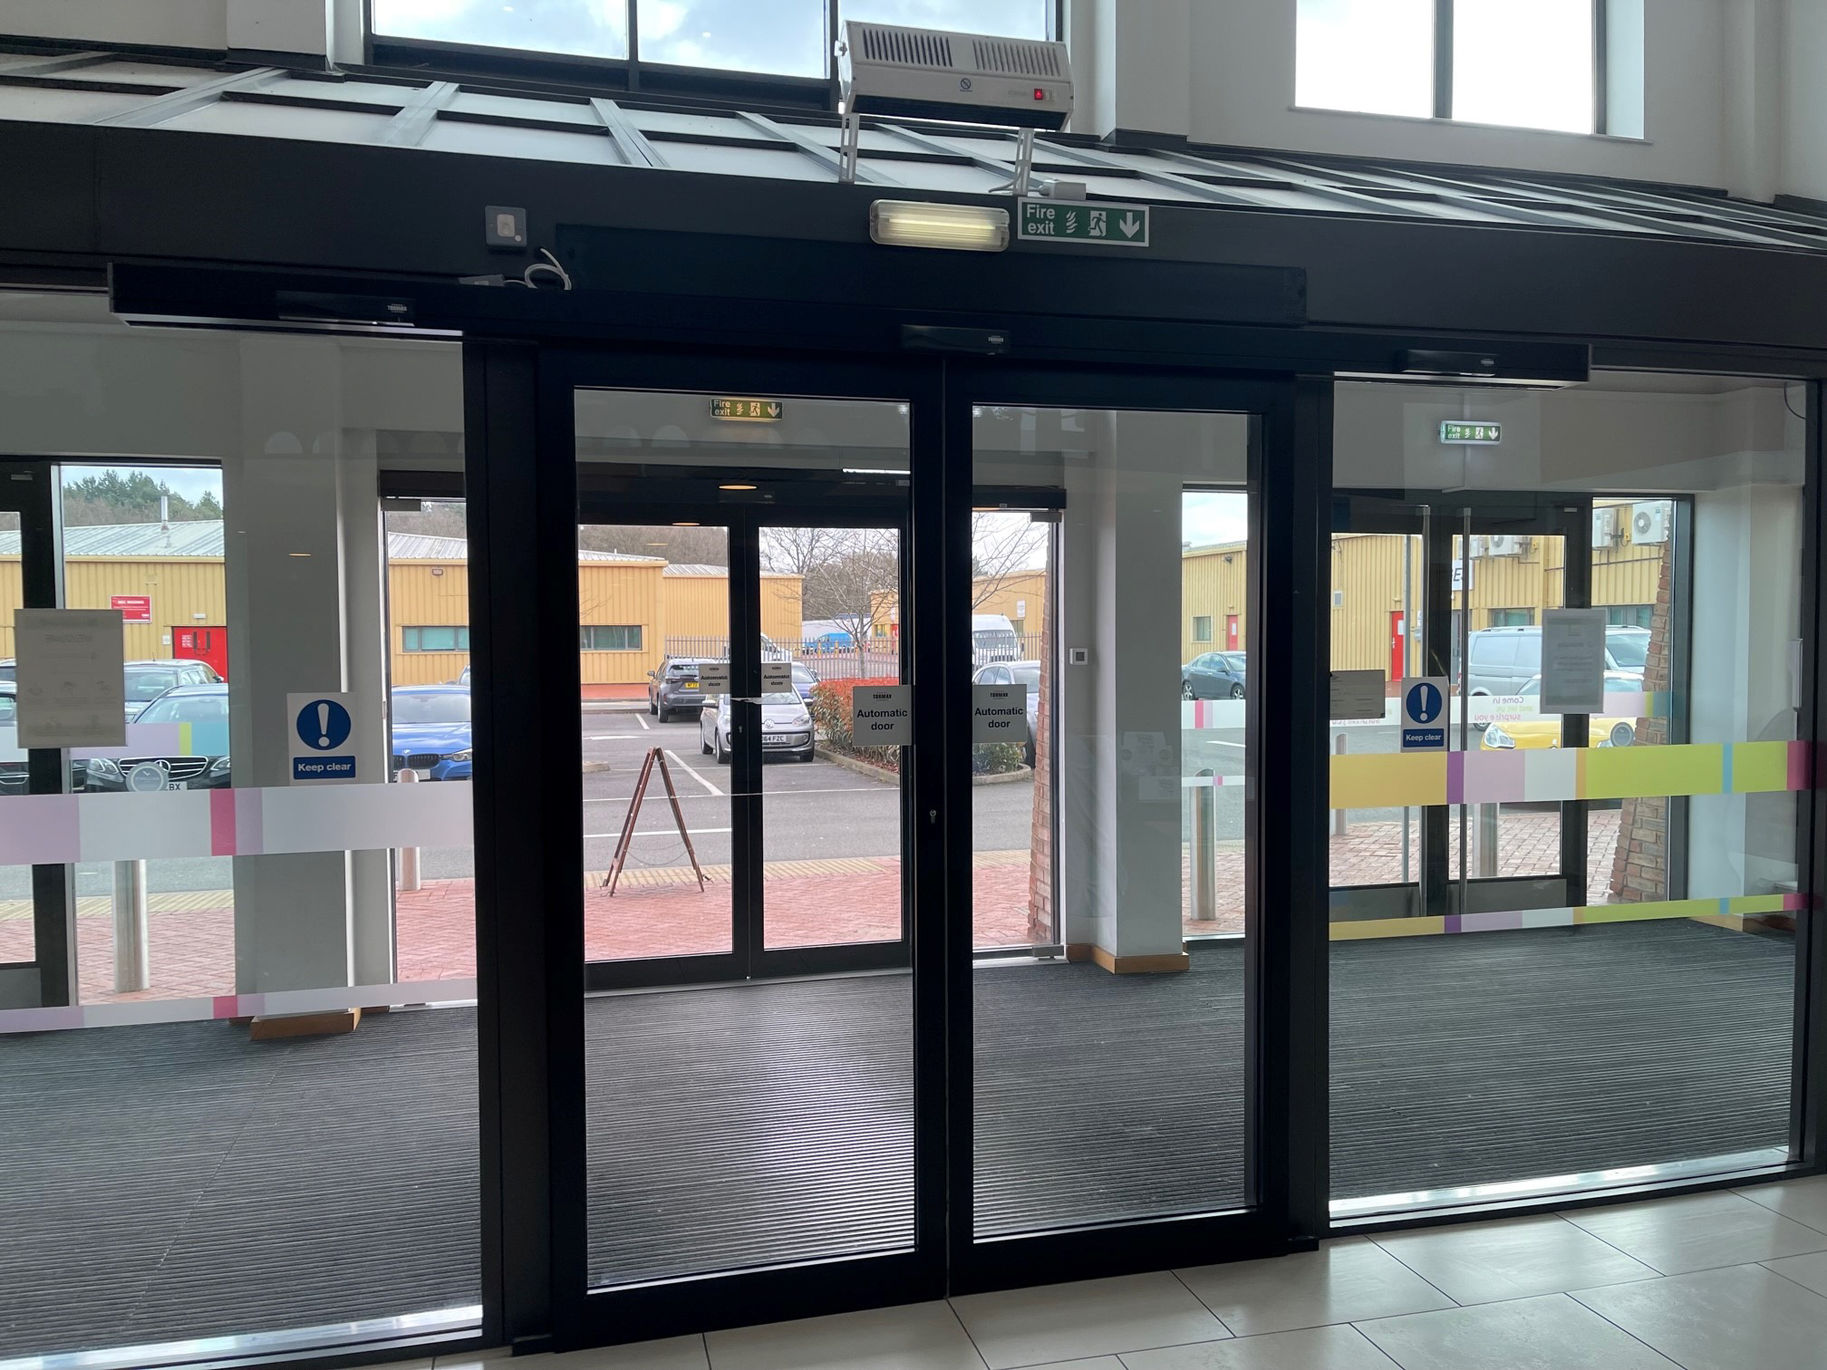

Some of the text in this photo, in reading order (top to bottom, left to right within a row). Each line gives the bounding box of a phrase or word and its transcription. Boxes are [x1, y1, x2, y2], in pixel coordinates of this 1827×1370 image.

[1026, 204, 1056, 219] Fire
[1027, 221, 1055, 235] exit
[713, 399, 731, 408] Fire
[714, 408, 731, 416] exit
[856, 708, 908, 718] Automatic
[974, 706, 1024, 716] Automatic
[870, 721, 895, 731] door
[988, 720, 1011, 729] door
[1406, 733, 1442, 742] Keep clear
[297, 762, 352, 773] Keep clear
[168, 783, 181, 791] BX
